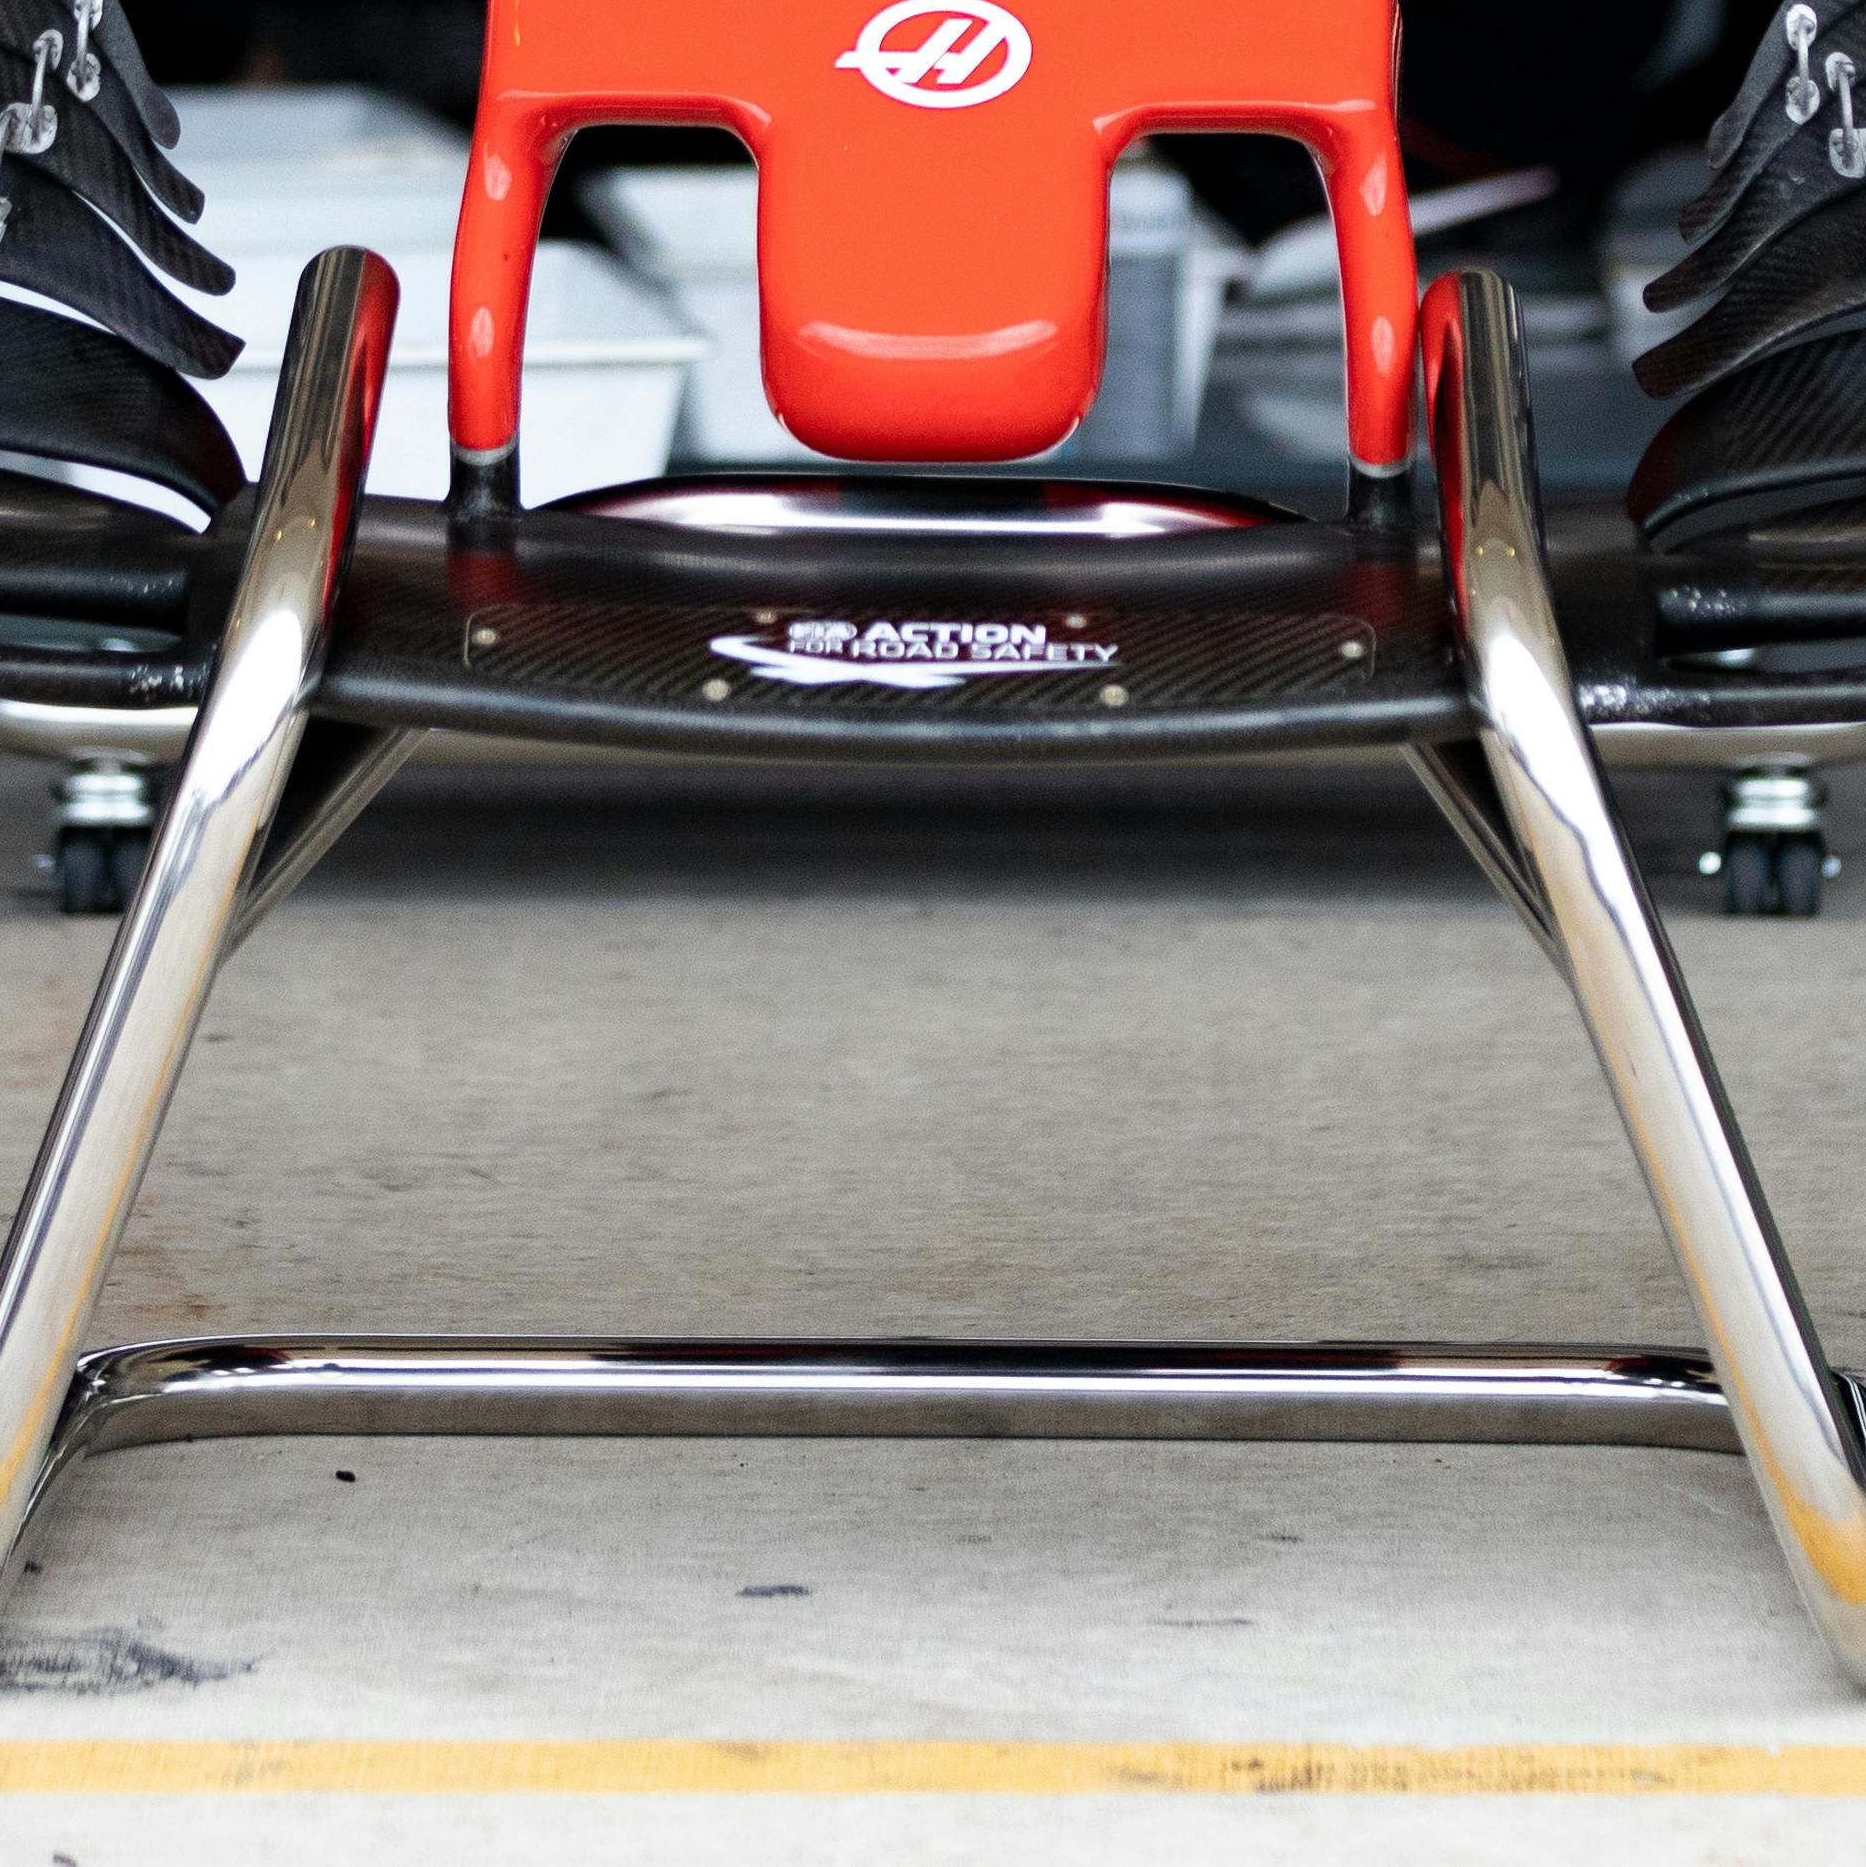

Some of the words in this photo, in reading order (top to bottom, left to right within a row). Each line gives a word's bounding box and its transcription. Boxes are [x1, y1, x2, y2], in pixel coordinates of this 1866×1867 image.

[864, 621, 1047, 645] ACTION
[789, 639, 843, 653] FOR
[852, 639, 959, 659] ROAD
[971, 642, 1119, 662] SAFETY
